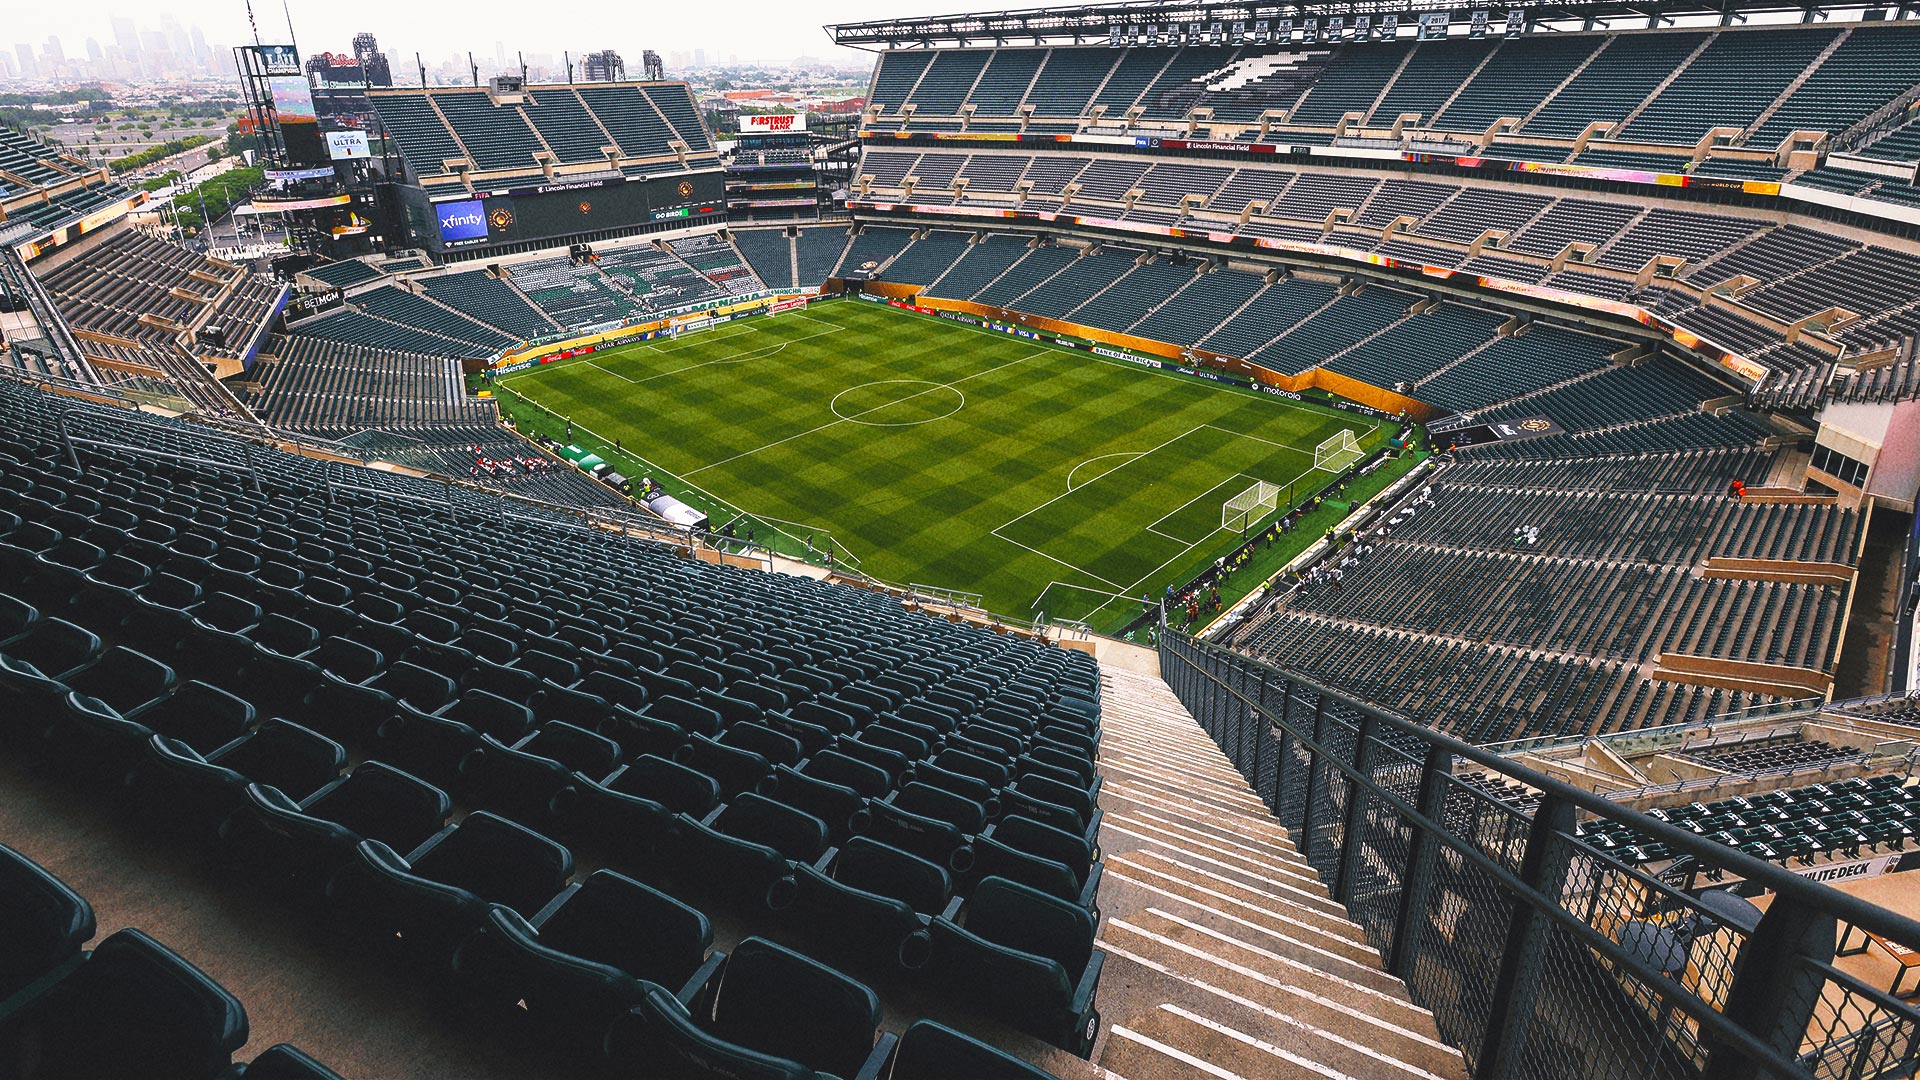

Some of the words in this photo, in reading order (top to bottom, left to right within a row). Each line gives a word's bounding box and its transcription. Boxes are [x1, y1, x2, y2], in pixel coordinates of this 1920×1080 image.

[750, 115, 795, 125] FIRSTRUST
[333, 138, 362, 146] ULTRA
[545, 184, 565, 192] Lincoln
[566, 182, 590, 190] Financial
[441, 213, 482, 229] xfinity
[666, 210, 683, 218] BIRDS
[304, 291, 339, 309] BETMGM
[691, 293, 760, 311] MANCHA
[629, 309, 678, 324] MANCHA
[940, 312, 955, 320] QATAR
[957, 316, 976, 325] AIRWAYS
[992, 323, 1003, 332] VISA
[1017, 329, 1030, 338] VISA
[594, 342, 615, 351] QATAR
[616, 336, 640, 346] AIRWAYS
[1095, 348, 1112, 356] BANK
[1122, 354, 1150, 365] AMERICA
[495, 362, 532, 376] Hisense
[1198, 372, 1218, 380] ULTRA
[1263, 386, 1301, 401] motorola
[1837, 862, 1871, 878] DECK
